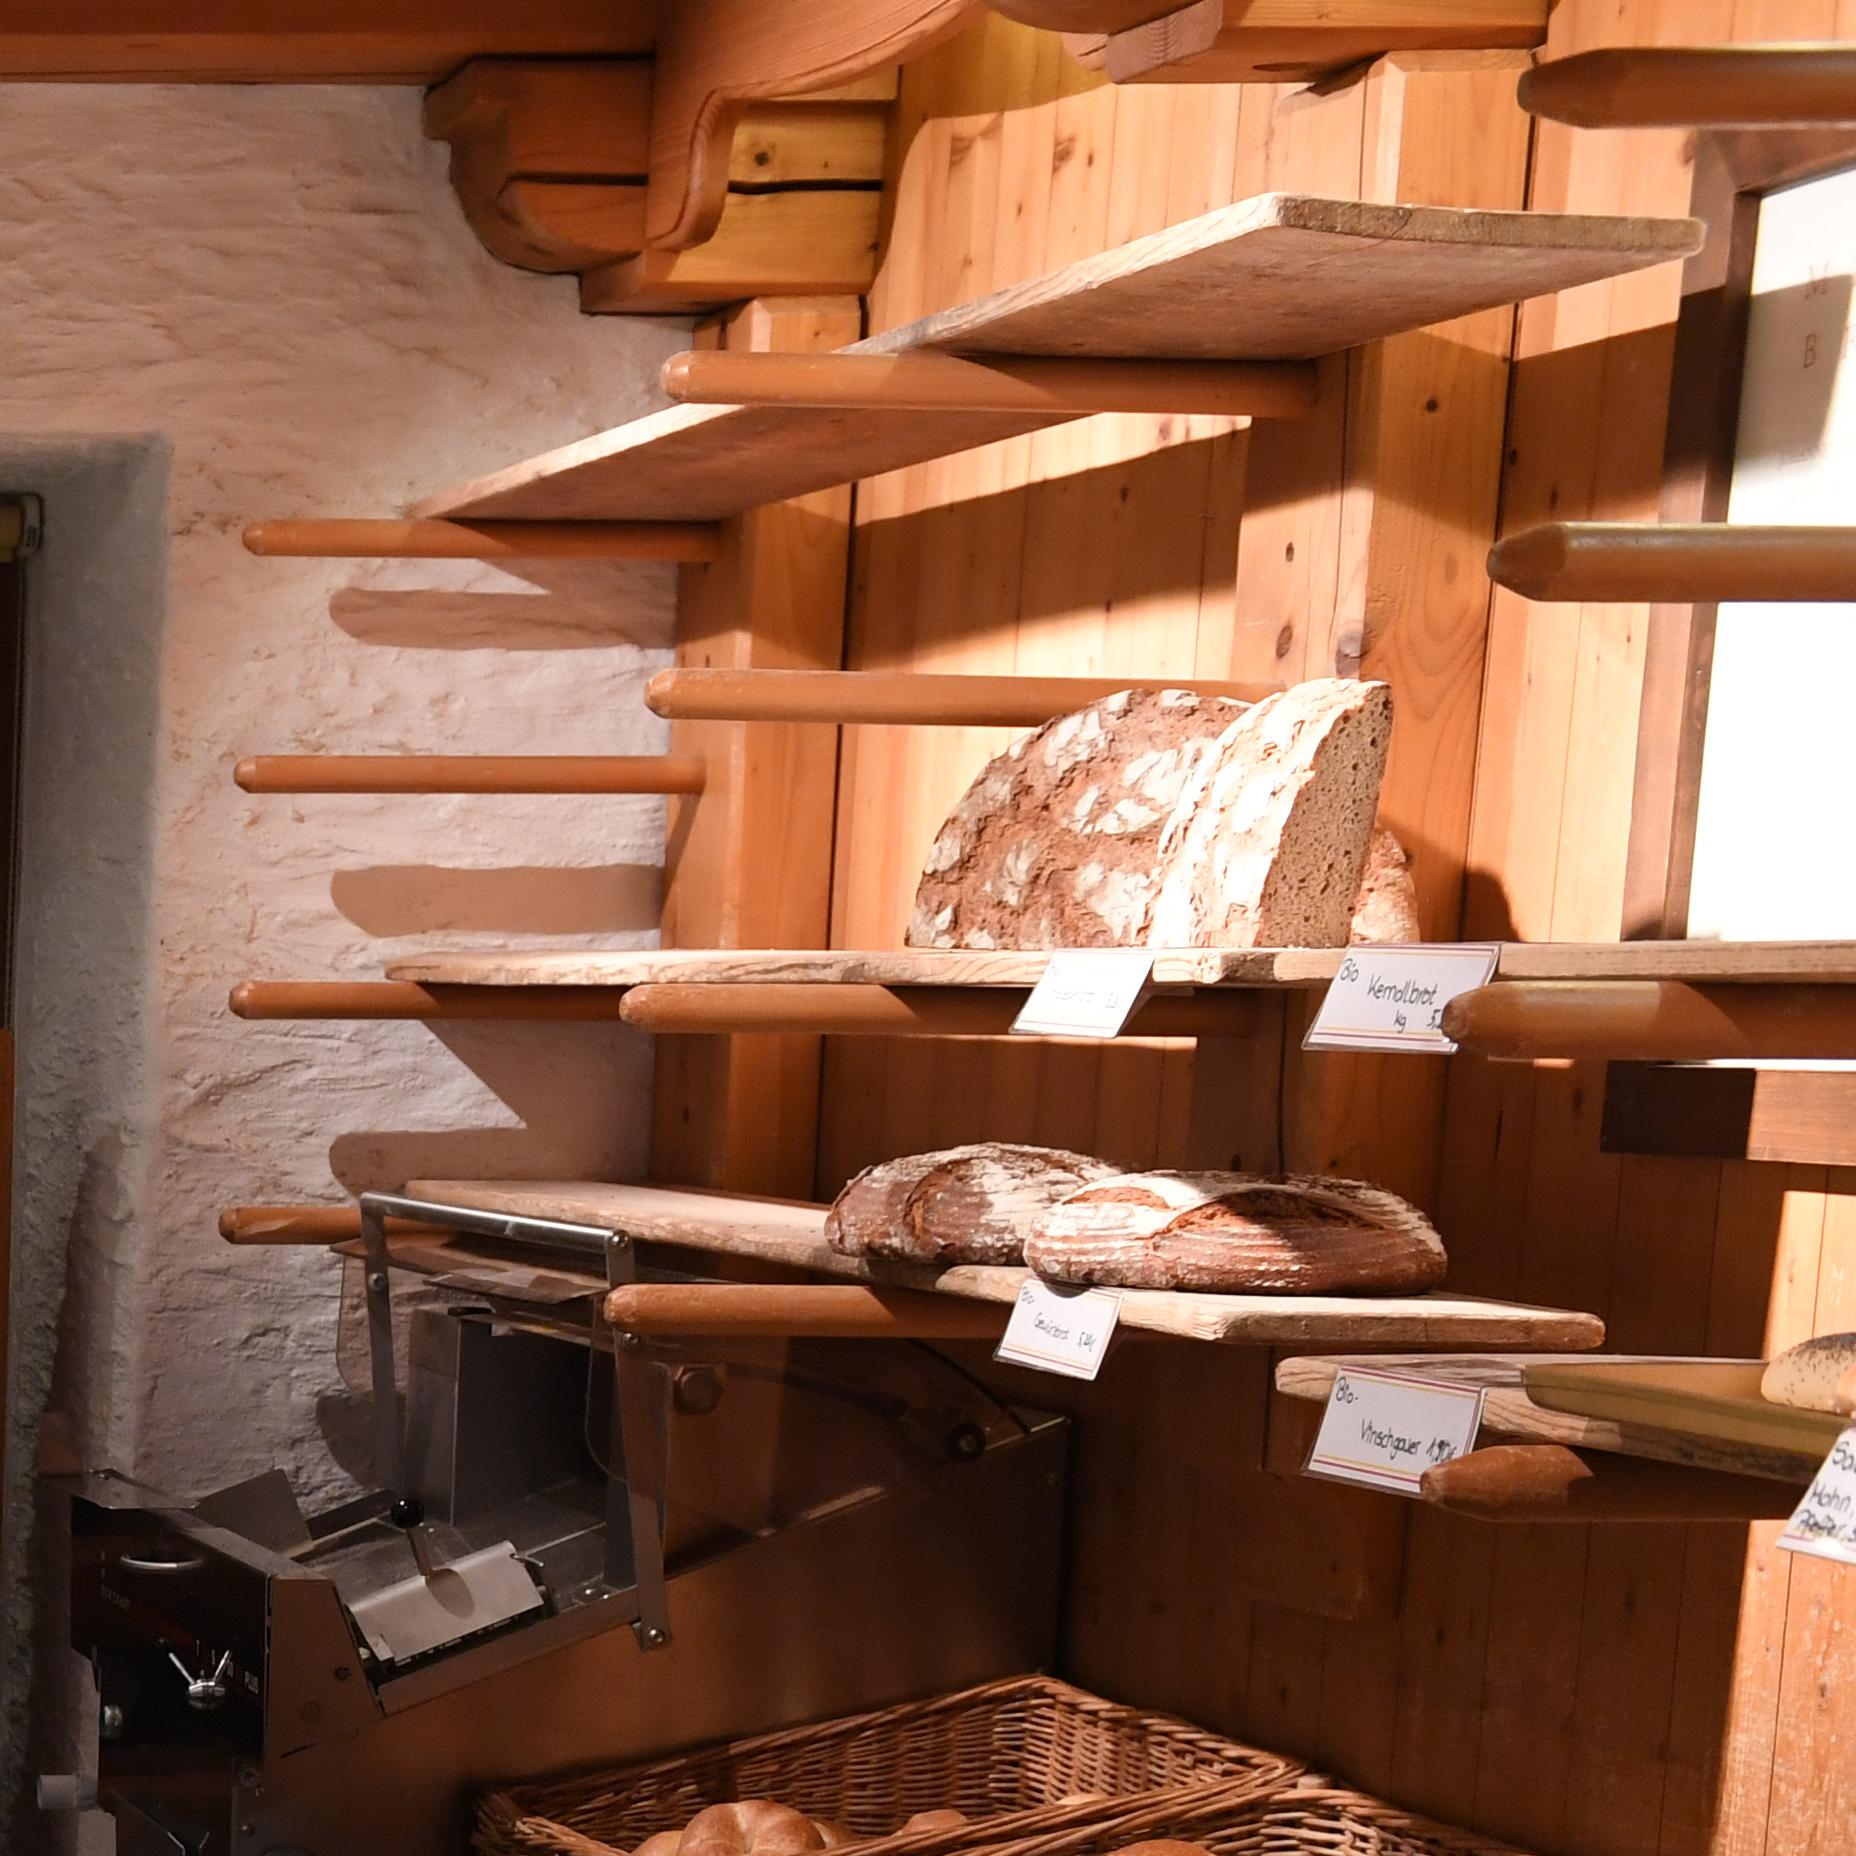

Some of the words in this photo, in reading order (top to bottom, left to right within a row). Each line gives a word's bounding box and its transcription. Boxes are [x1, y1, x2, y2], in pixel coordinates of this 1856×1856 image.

[1340, 957, 1359, 982] Bio
[1393, 1010, 1407, 1034] kg
[1361, 1418, 1422, 1461] Vinschgauer
[1832, 1440, 1856, 1474] Sa
